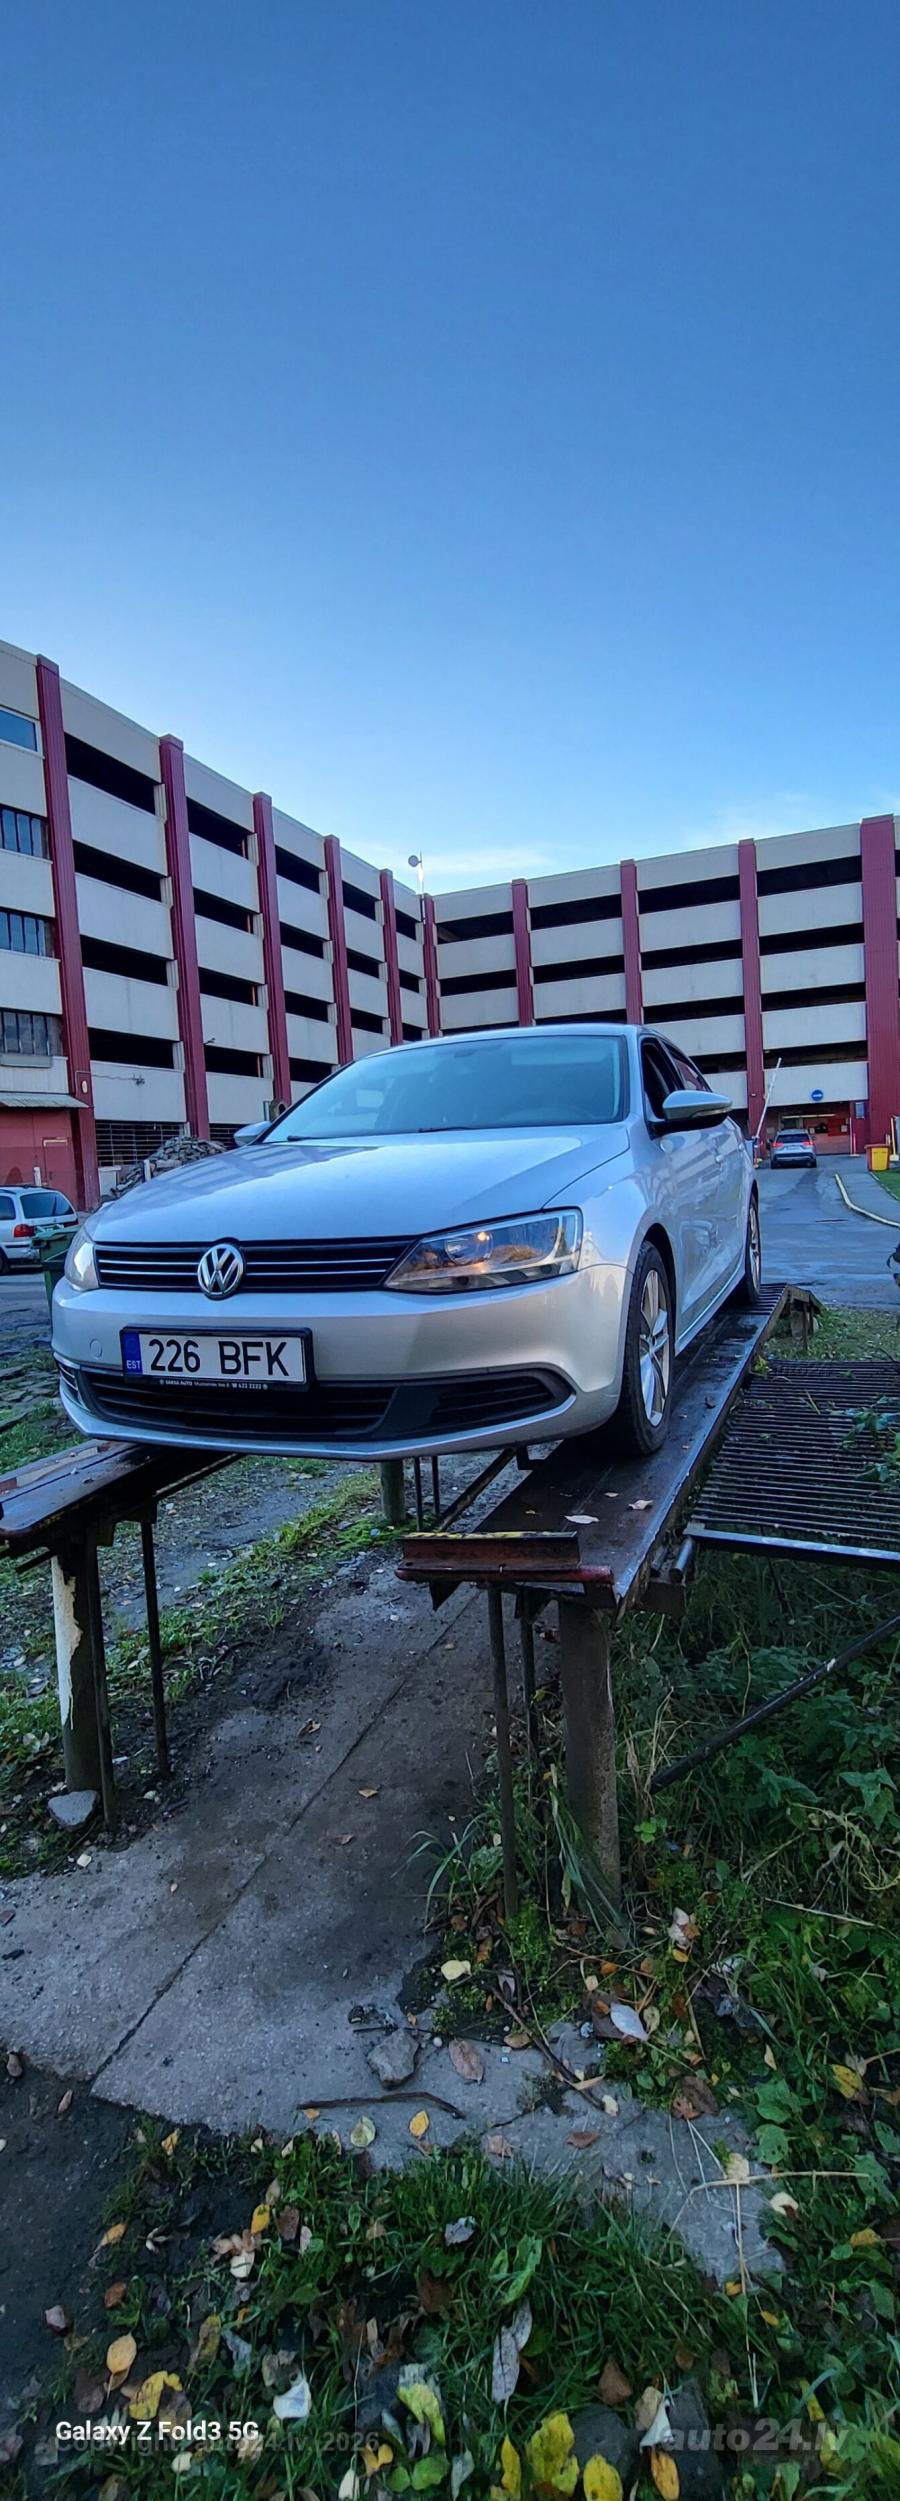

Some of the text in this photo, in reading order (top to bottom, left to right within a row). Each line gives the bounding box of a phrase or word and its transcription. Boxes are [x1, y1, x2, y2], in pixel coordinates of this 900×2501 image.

[126, 1360, 141, 1369] EST
[149, 1338, 289, 1376] 226 BFK
